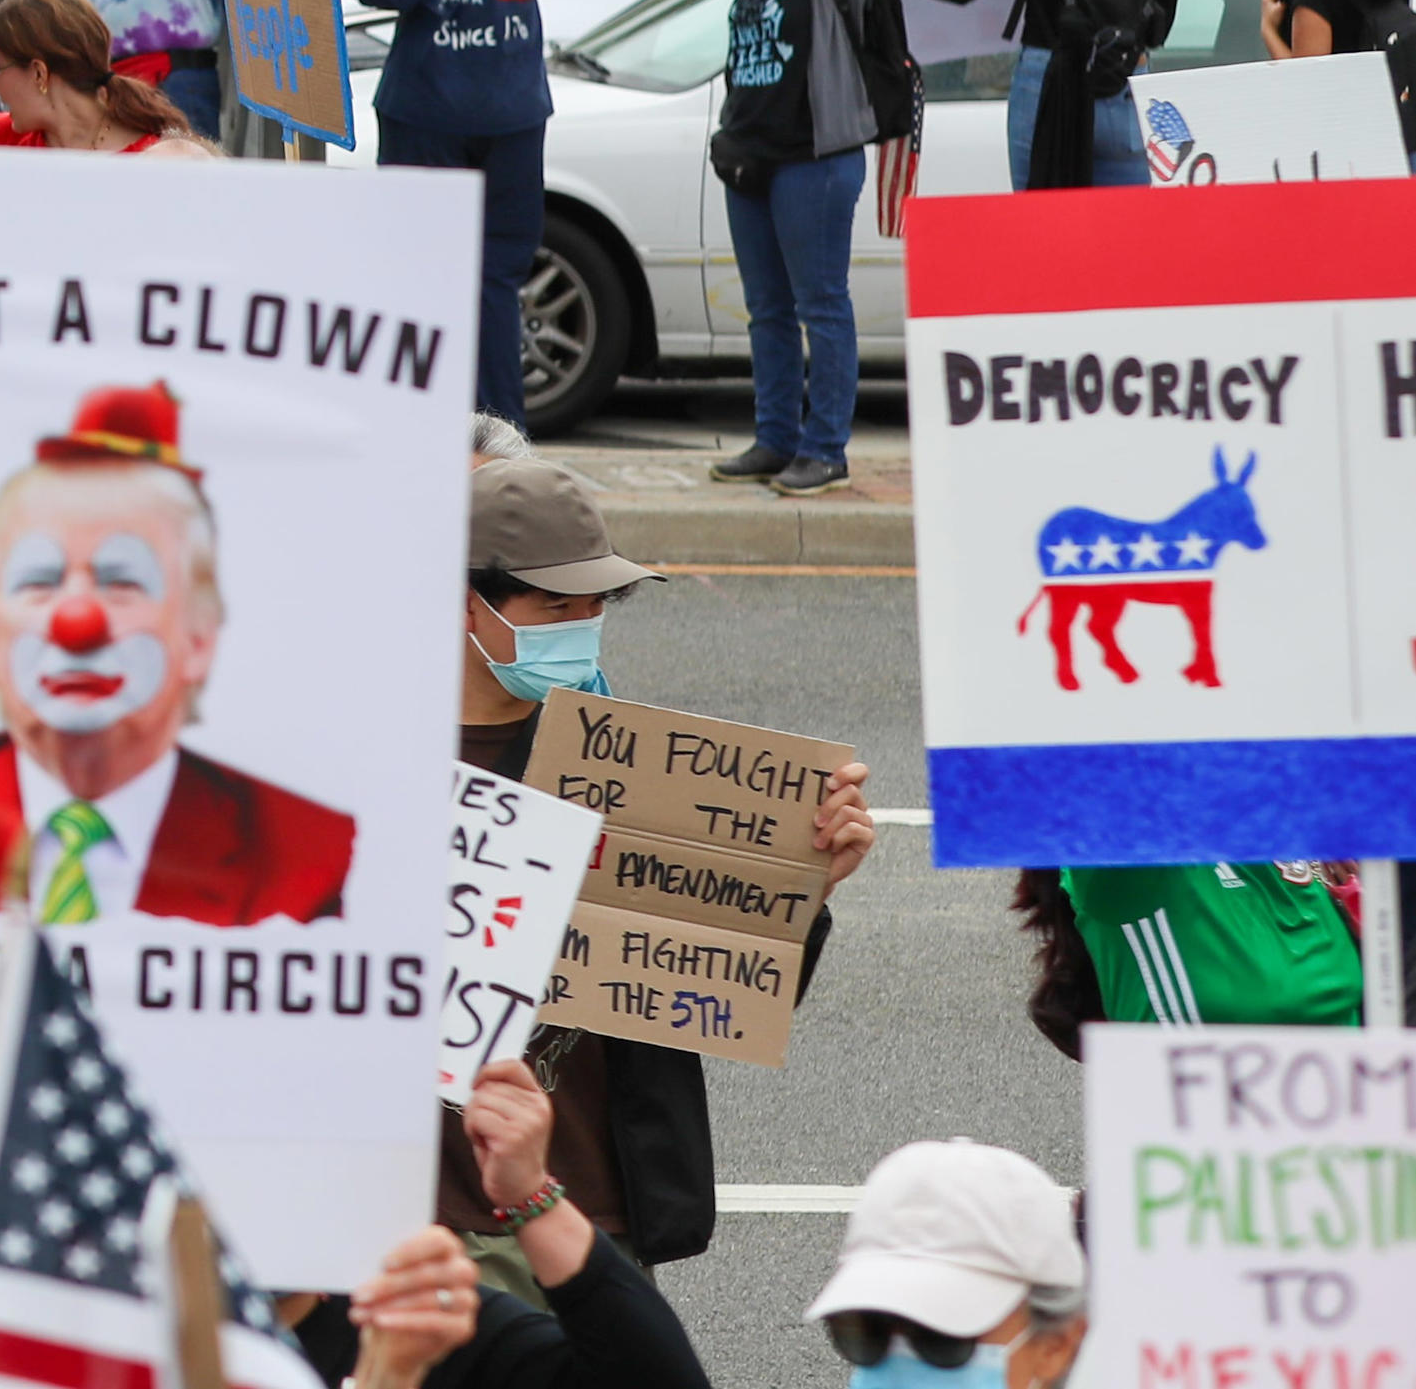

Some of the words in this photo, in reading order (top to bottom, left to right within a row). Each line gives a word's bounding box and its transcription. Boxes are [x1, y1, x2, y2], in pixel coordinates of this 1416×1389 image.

[52, 279, 93, 345] A
[138, 280, 447, 392] CLOWN
[943, 350, 1300, 427] DEMOCRACY
[578, 707, 637, 769] YOU
[666, 731, 835, 806] FOUGHT
[558, 773, 627, 809] FOR
[695, 804, 778, 847] THE
[615, 851, 809, 924] AMENDMENT
[139, 948, 424, 1018] CIRCUS
[622, 929, 782, 997] FIGHTING
[599, 982, 665, 1021] THE
[670, 991, 745, 1041] 5TH.
[1165, 1042, 1416, 1132] FROM
[1242, 1267, 1357, 1331] TO
